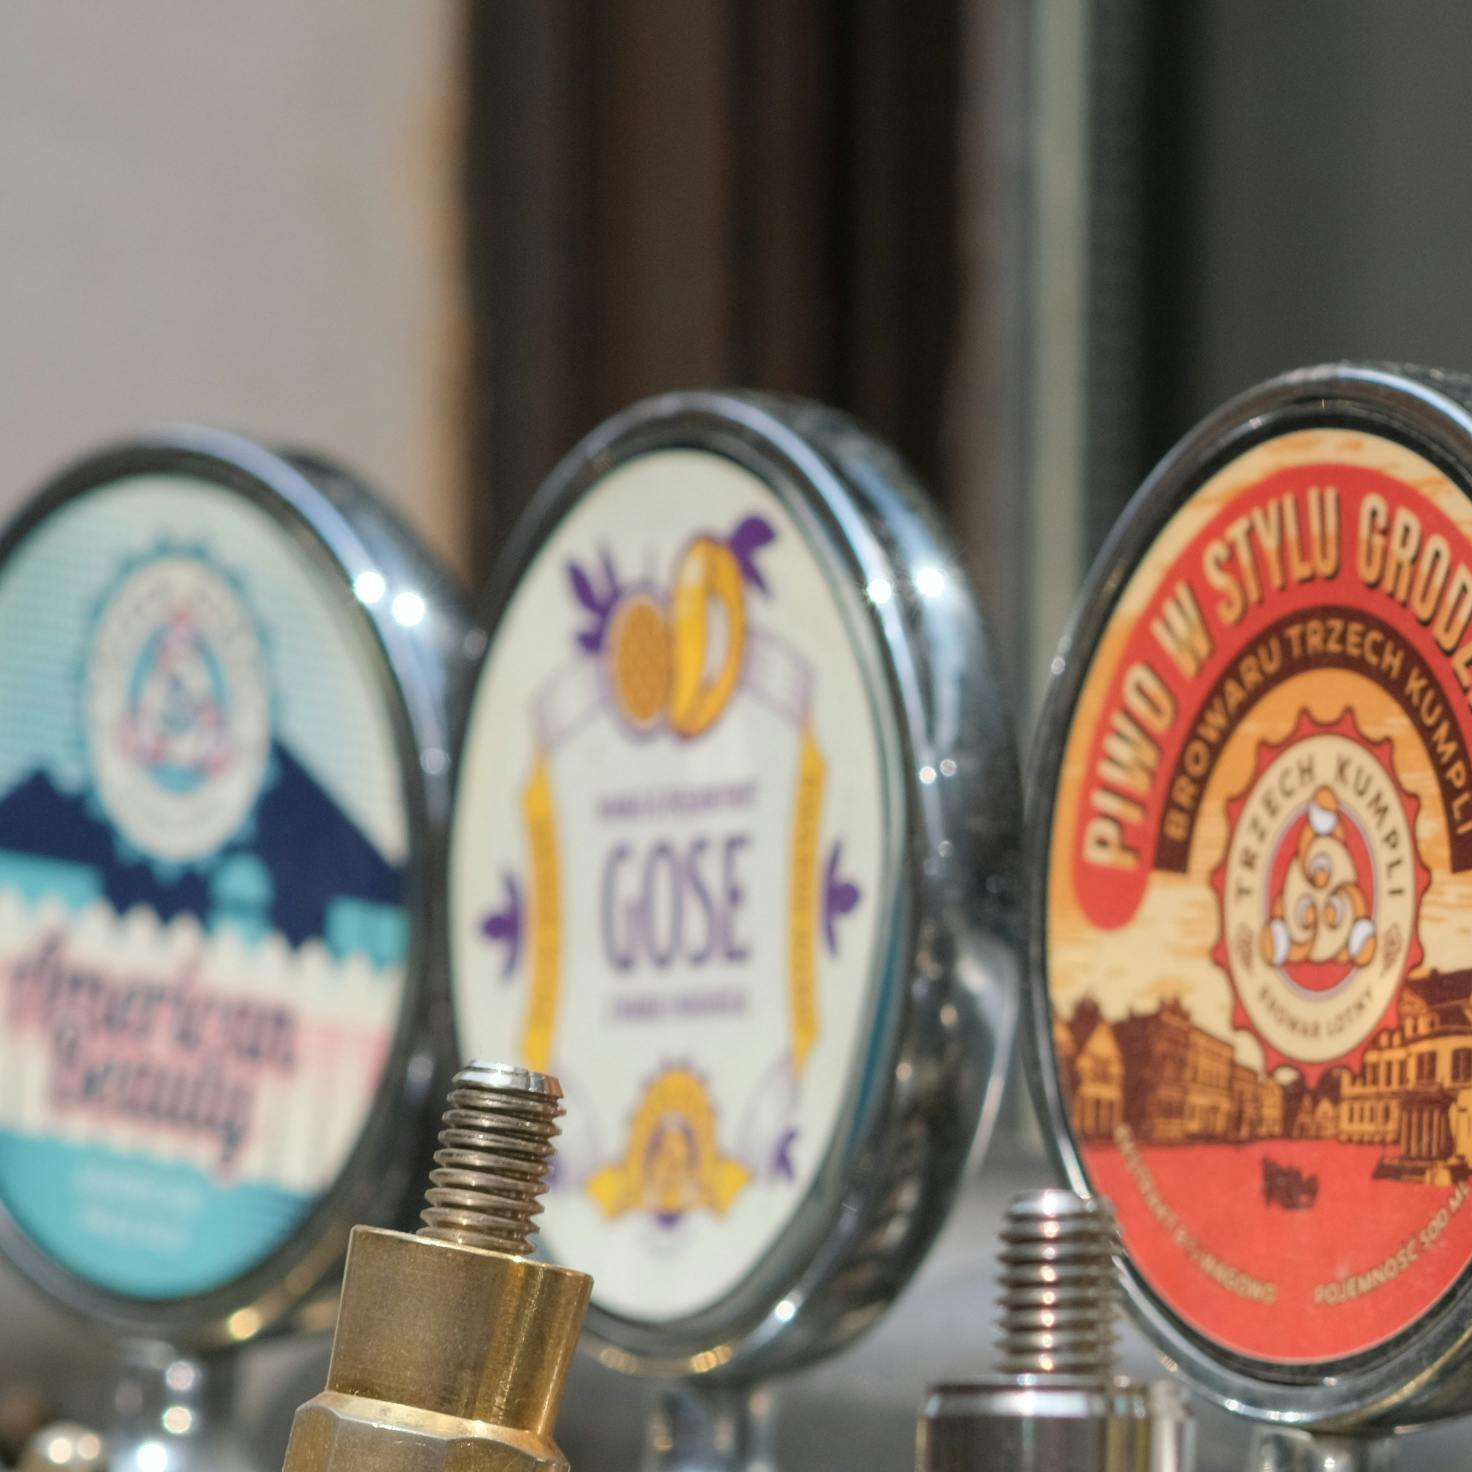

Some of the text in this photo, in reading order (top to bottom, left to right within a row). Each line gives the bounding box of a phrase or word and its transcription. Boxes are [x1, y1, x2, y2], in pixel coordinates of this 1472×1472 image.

[1082, 662, 1178, 871] PIWO
[1150, 580, 1214, 680] W
[1204, 486, 1341, 624] STYLU
[1164, 637, 1283, 842] BROWARU
[1283, 618, 1404, 678] TRZECH
[601, 834, 751, 972] GOSE
[1236, 751, 1405, 898] TRZECH KUMPLI
